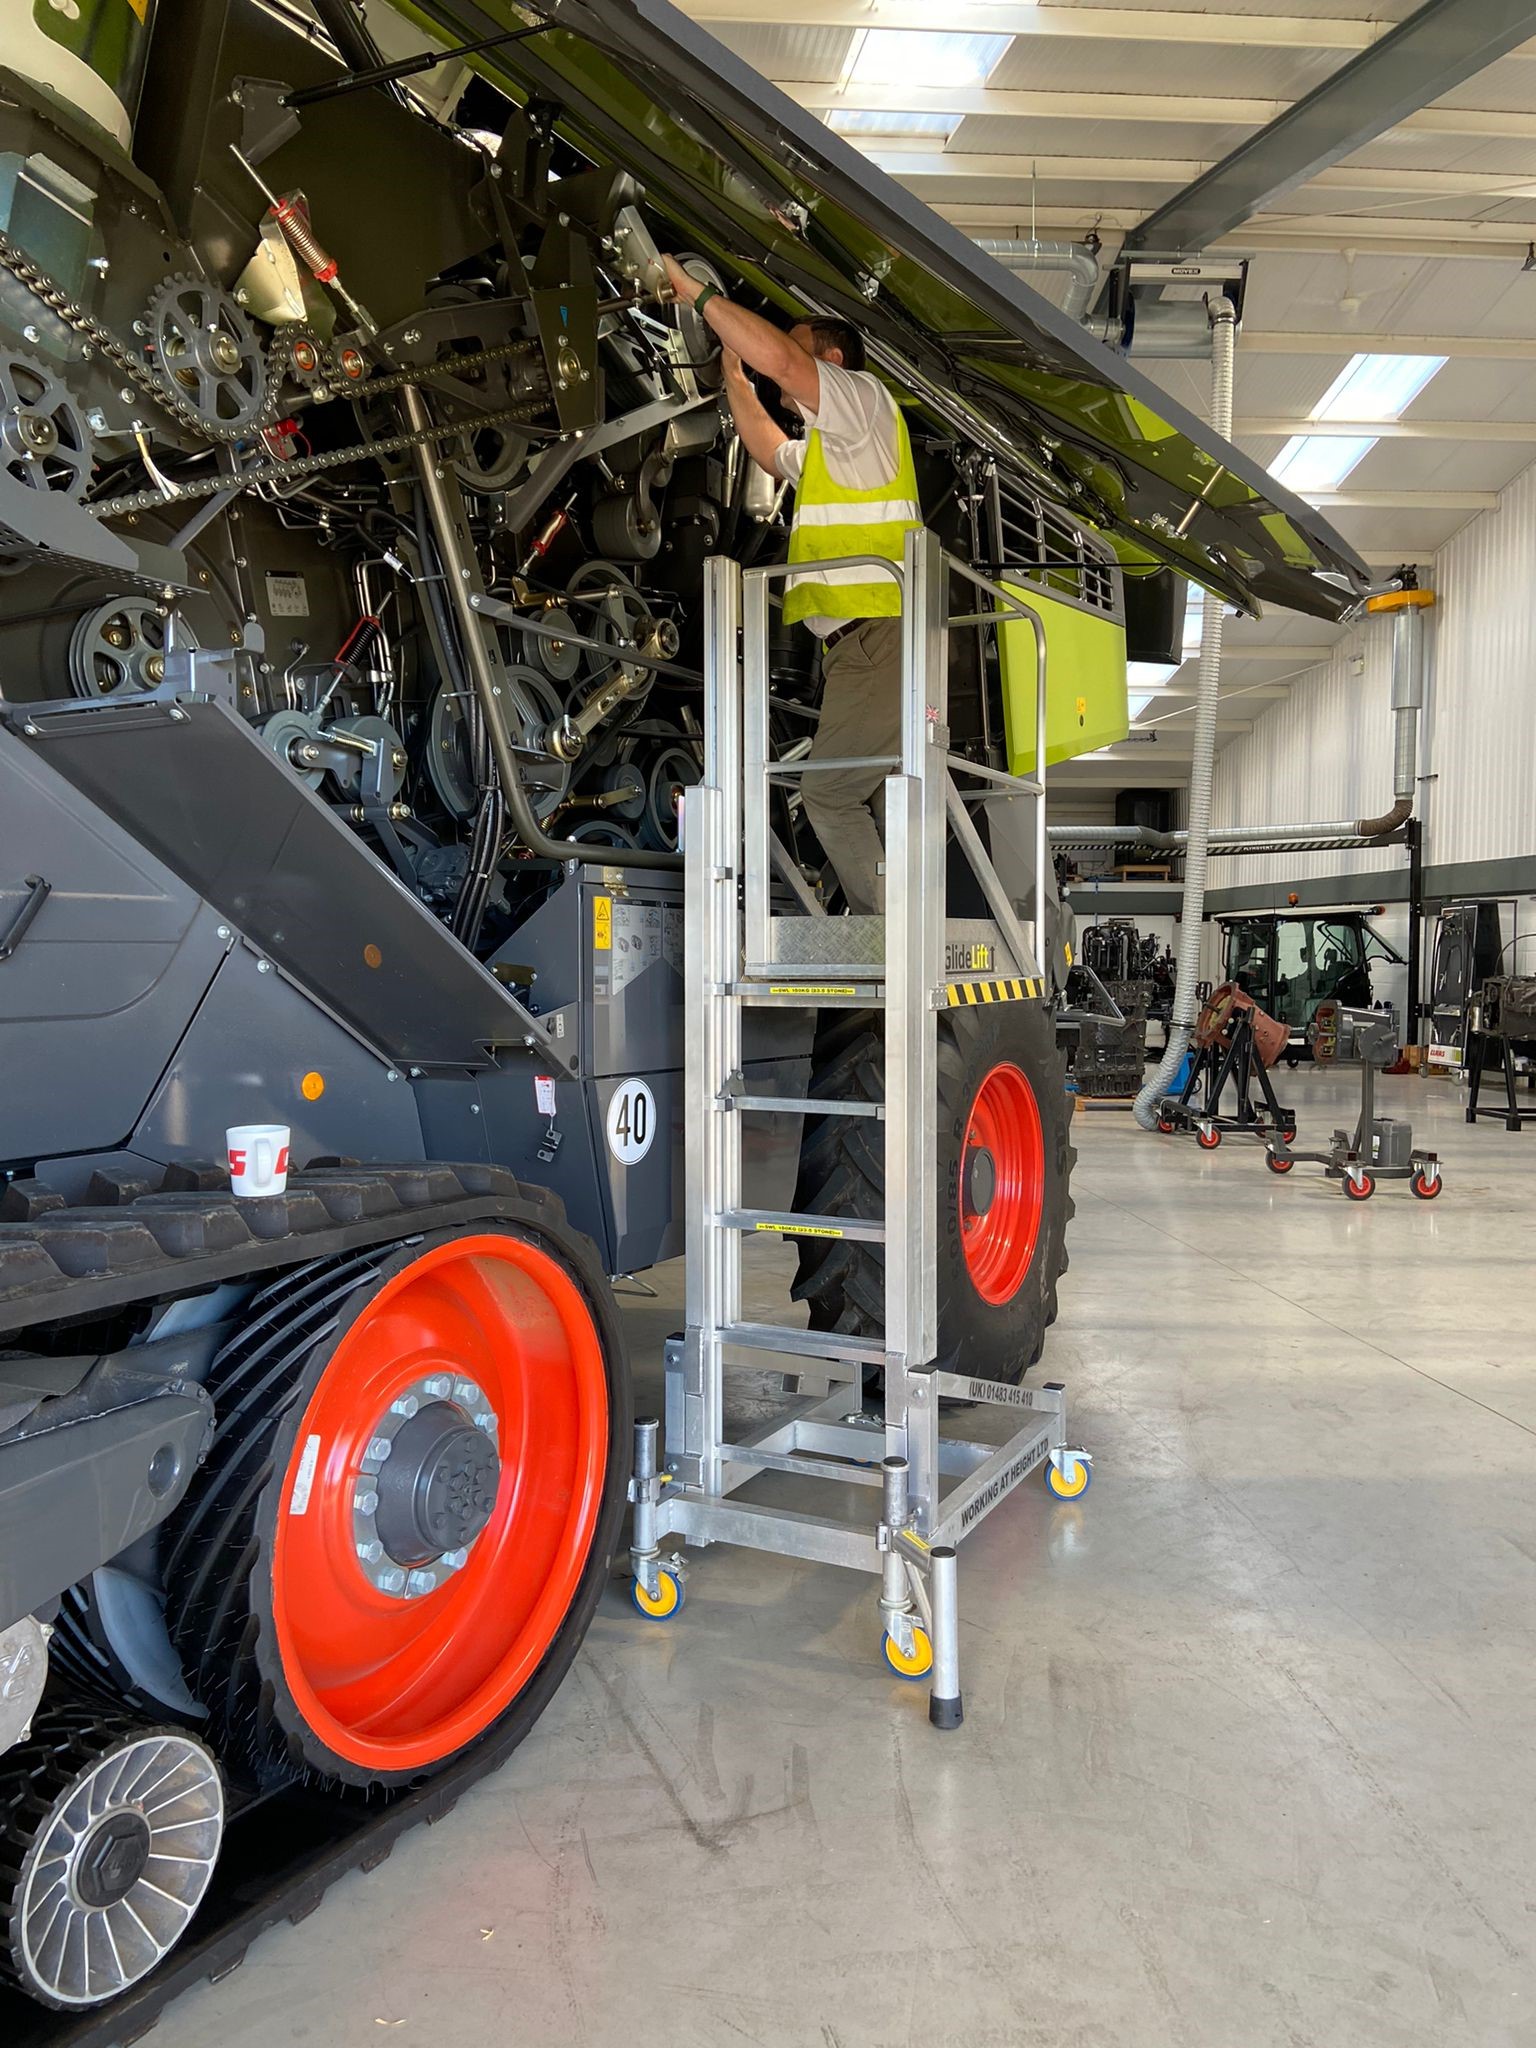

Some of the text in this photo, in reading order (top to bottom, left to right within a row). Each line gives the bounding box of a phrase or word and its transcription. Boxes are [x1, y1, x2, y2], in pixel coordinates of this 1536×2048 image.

[615, 1092, 647, 1147] 40
[969, 1380, 1033, 1406] (UK) 01483 415 410
[961, 1437, 1049, 1527] WORKING AT HEIGHT LTD
